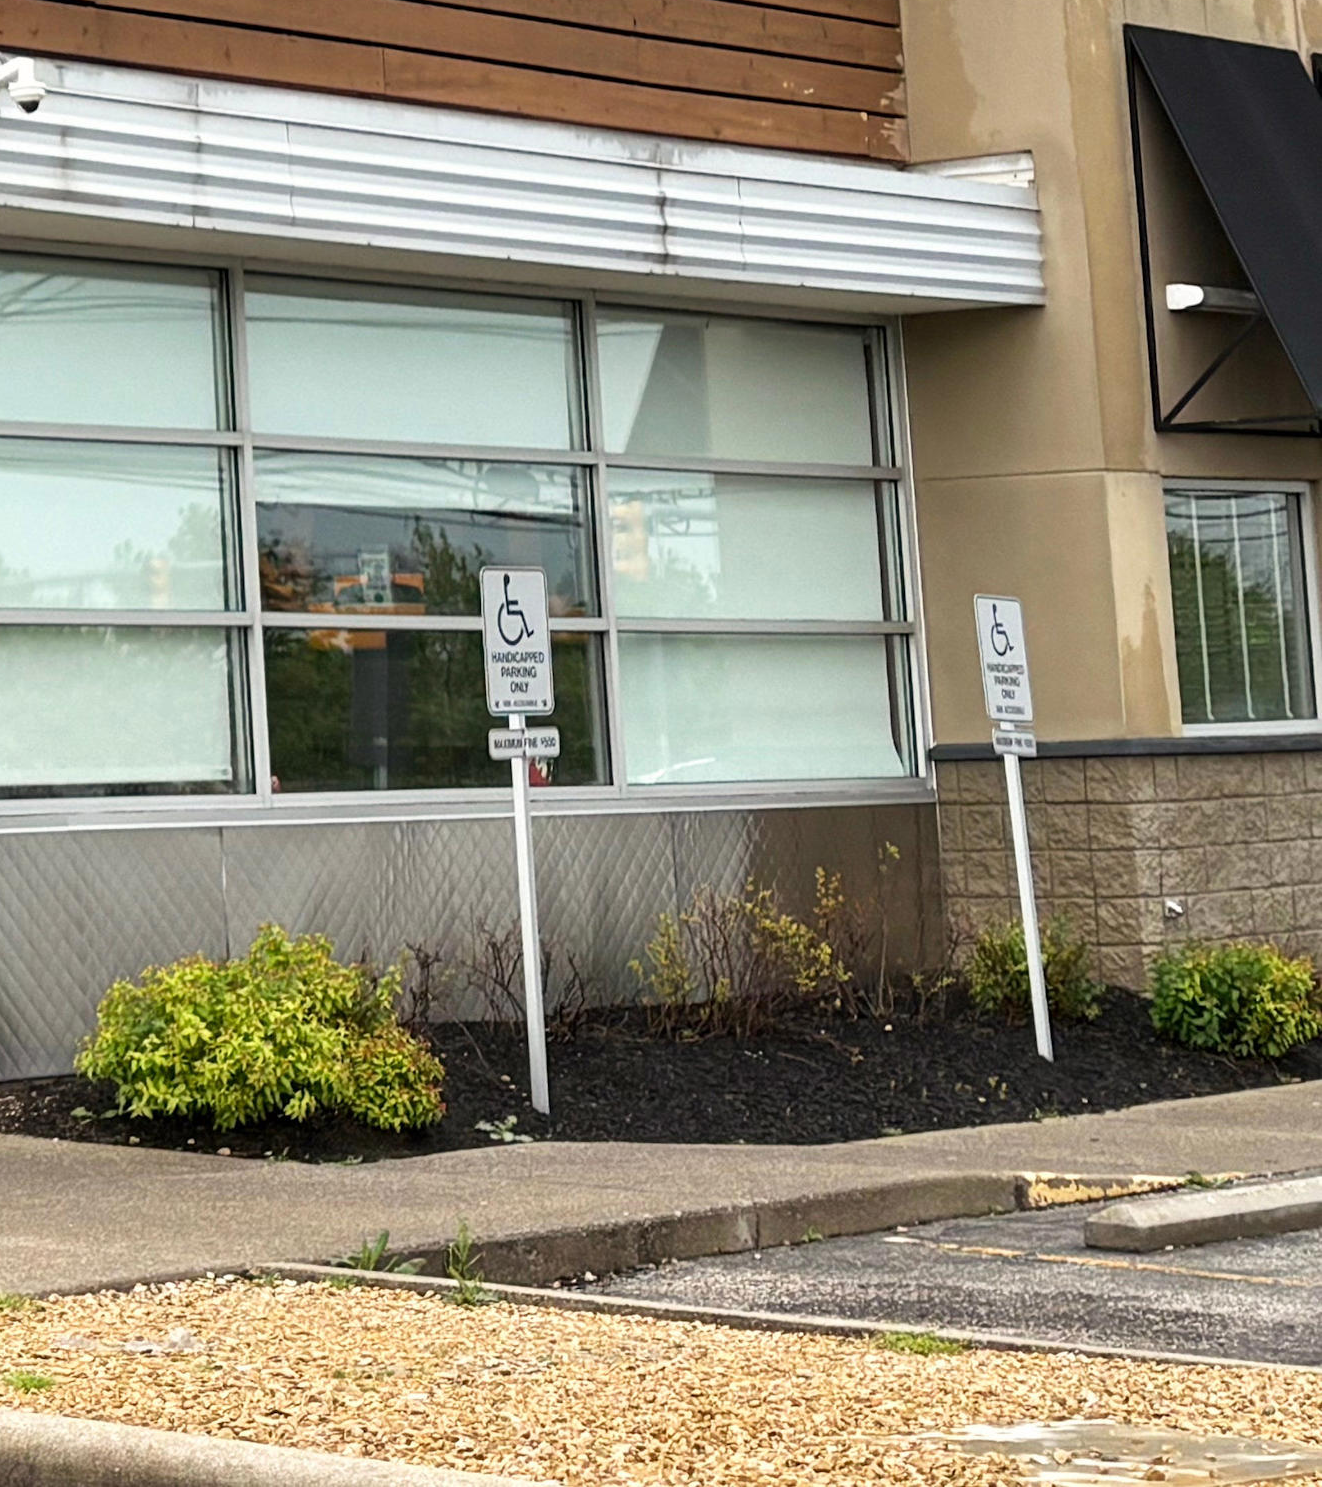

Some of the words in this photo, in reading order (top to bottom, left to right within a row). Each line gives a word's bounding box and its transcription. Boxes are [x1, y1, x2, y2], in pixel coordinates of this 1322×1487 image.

[491, 651, 545, 664] HANDICAPPED
[500, 666, 537, 679] PARKING
[986, 663, 1025, 675] HANDICAPPED
[510, 681, 529, 693] ONLY
[993, 676, 1021, 687] PARKING
